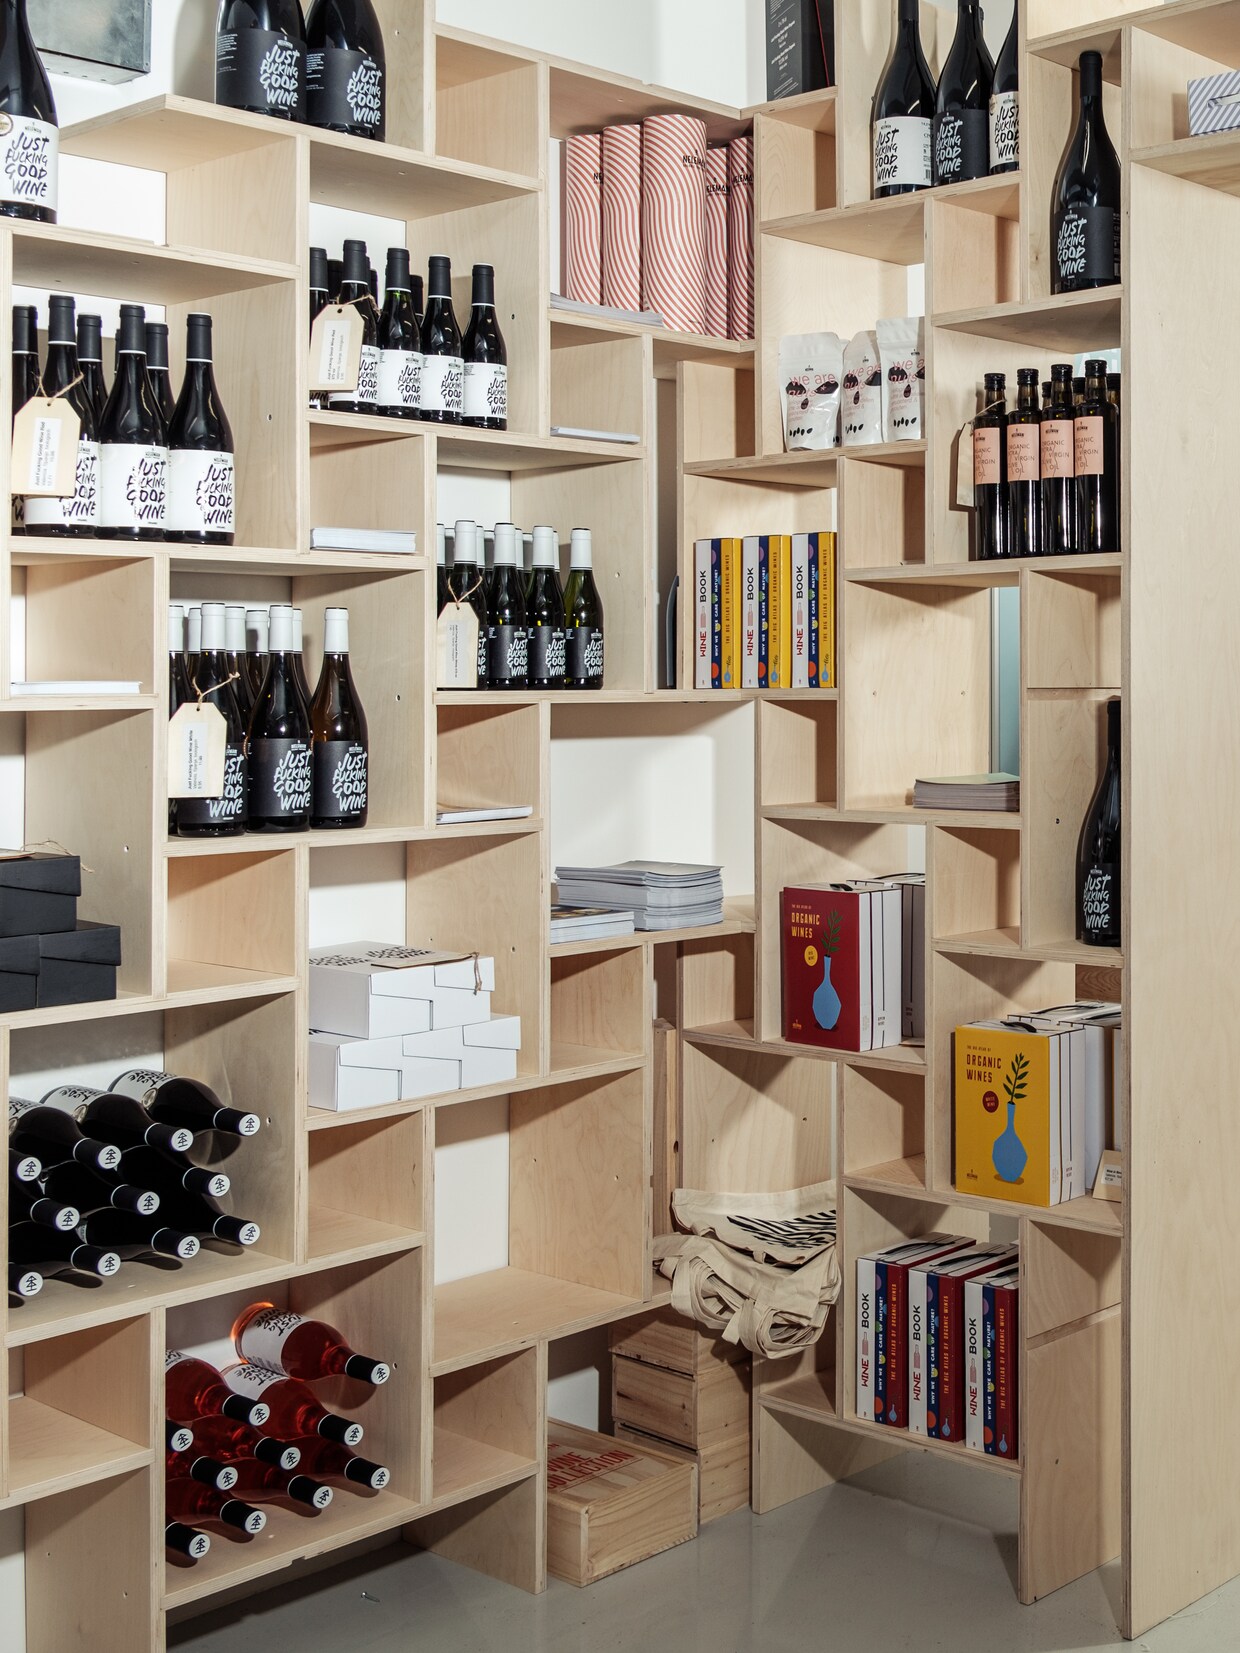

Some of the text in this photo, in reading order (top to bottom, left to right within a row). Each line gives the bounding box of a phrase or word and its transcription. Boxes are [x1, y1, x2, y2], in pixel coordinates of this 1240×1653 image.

[266, 45, 300, 63] JUST
[260, 60, 298, 78] FUCKING
[352, 65, 382, 83] JUST
[260, 74, 298, 90] GOOD
[347, 79, 381, 98] FUCKING
[266, 87, 298, 107] WINE
[347, 93, 381, 110] GOOD
[353, 108, 381, 125] WINE
[937, 120, 963, 139] JUST
[12, 132, 49, 152] JUST
[936, 136, 961, 149] FUCKING
[5, 148, 48, 167] FUCKING
[936, 148, 961, 161] GOOD
[5, 163, 48, 180] GOOD
[938, 158, 962, 176] WINE
[12, 178, 48, 197] WINE
[1059, 218, 1087, 239] JUST
[1058, 234, 1085, 252] FUCKING
[1058, 246, 1085, 265] GOOD
[1060, 258, 1086, 277] WINE
[444, 370, 462, 381] JUST
[790, 373, 836, 385] we are
[440, 389, 462, 398] GOOD
[441, 381, 462, 389] FUCKING
[359, 390, 378, 399] WINE
[445, 399, 462, 408] WINE
[203, 464, 233, 482] JUST
[126, 489, 165, 505] GOOD
[204, 509, 232, 524] WINE
[279, 750, 312, 769] JUST
[338, 751, 368, 771] JUST
[273, 766, 311, 783] FUCKING
[332, 768, 366, 785] FUCKING
[273, 780, 311, 797] GOOD
[332, 782, 366, 797] GOOD
[206, 799, 243, 818] WINE
[280, 793, 311, 811] WINE
[338, 795, 366, 812] WINE
[1085, 874, 1111, 891] JUST
[1083, 889, 1109, 902] FUCKING
[1083, 901, 1109, 915] GOOD
[792, 912, 820, 925] ORGANIC
[1086, 914, 1110, 928] WINE
[792, 927, 812, 938] WINES
[967, 1054, 1001, 1069] ORGANIC
[967, 1069, 992, 1083] WINES
[913, 1305, 921, 1342] BOOK
[969, 1317, 977, 1355] BOOK
[861, 1358, 869, 1387] WINE
